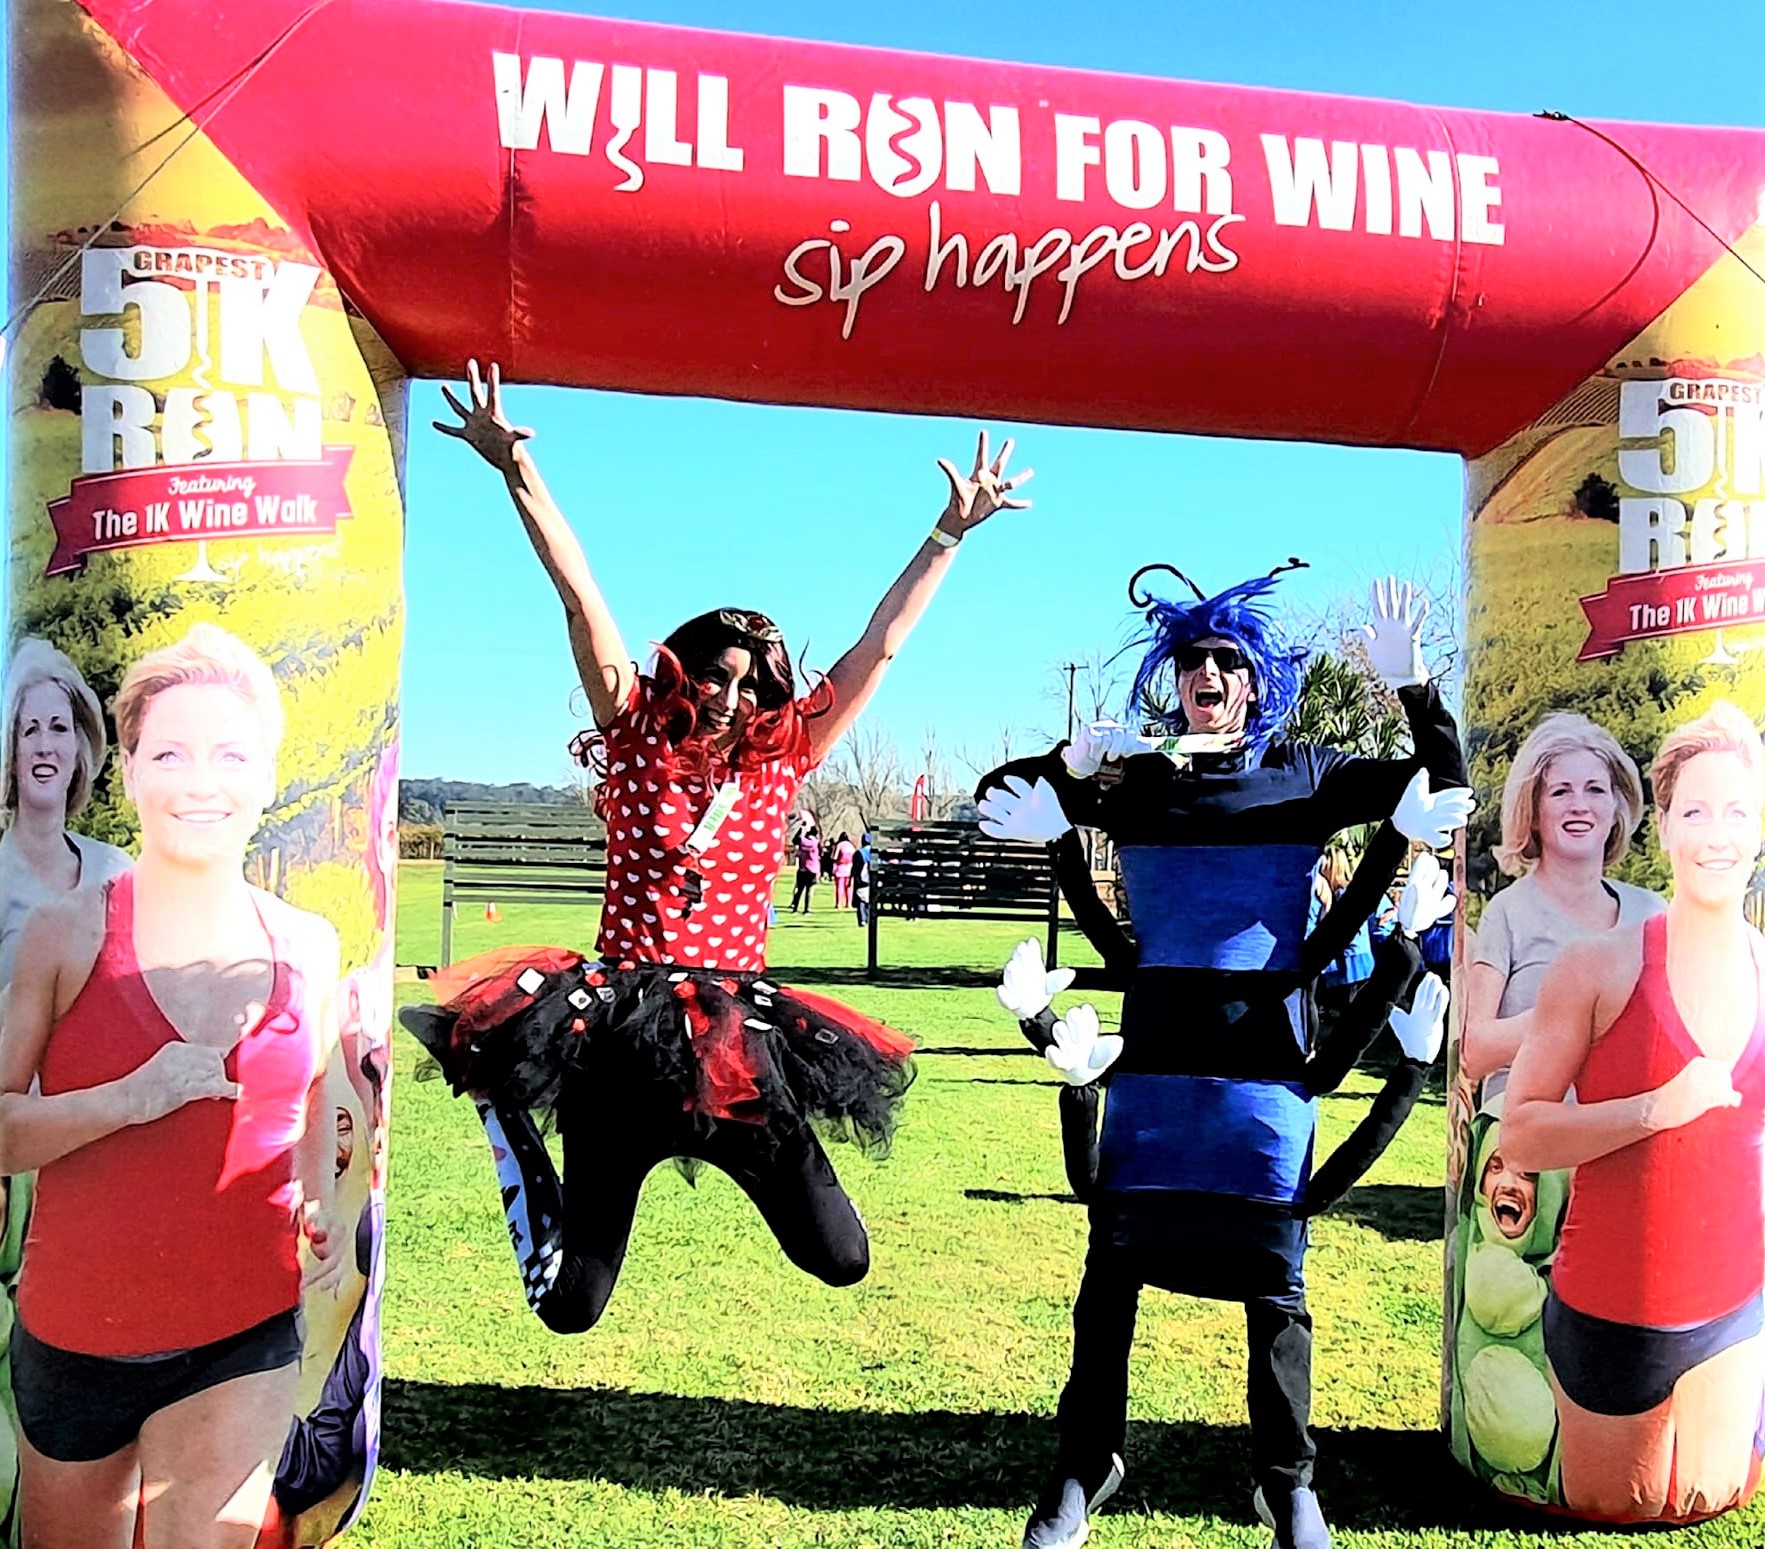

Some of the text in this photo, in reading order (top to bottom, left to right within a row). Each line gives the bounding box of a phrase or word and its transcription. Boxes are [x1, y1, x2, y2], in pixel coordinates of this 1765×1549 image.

[492, 51, 1505, 245] WILL RUN FOR WINE
[134, 250, 266, 280] GRAPEST
[774, 201, 1245, 340] sip happens
[1670, 382, 1761, 404] GRAPEST
[81, 385, 322, 473] RUN
[168, 475, 256, 497] Featuring
[92, 494, 318, 540] The 1K Wine Walk
[1619, 497, 1765, 574] RU
[1695, 571, 1753, 591] Featuring
[1630, 605, 1670, 630] The
[1676, 598, 1696, 623] 1K
[1702, 592, 1748, 620] Wine
